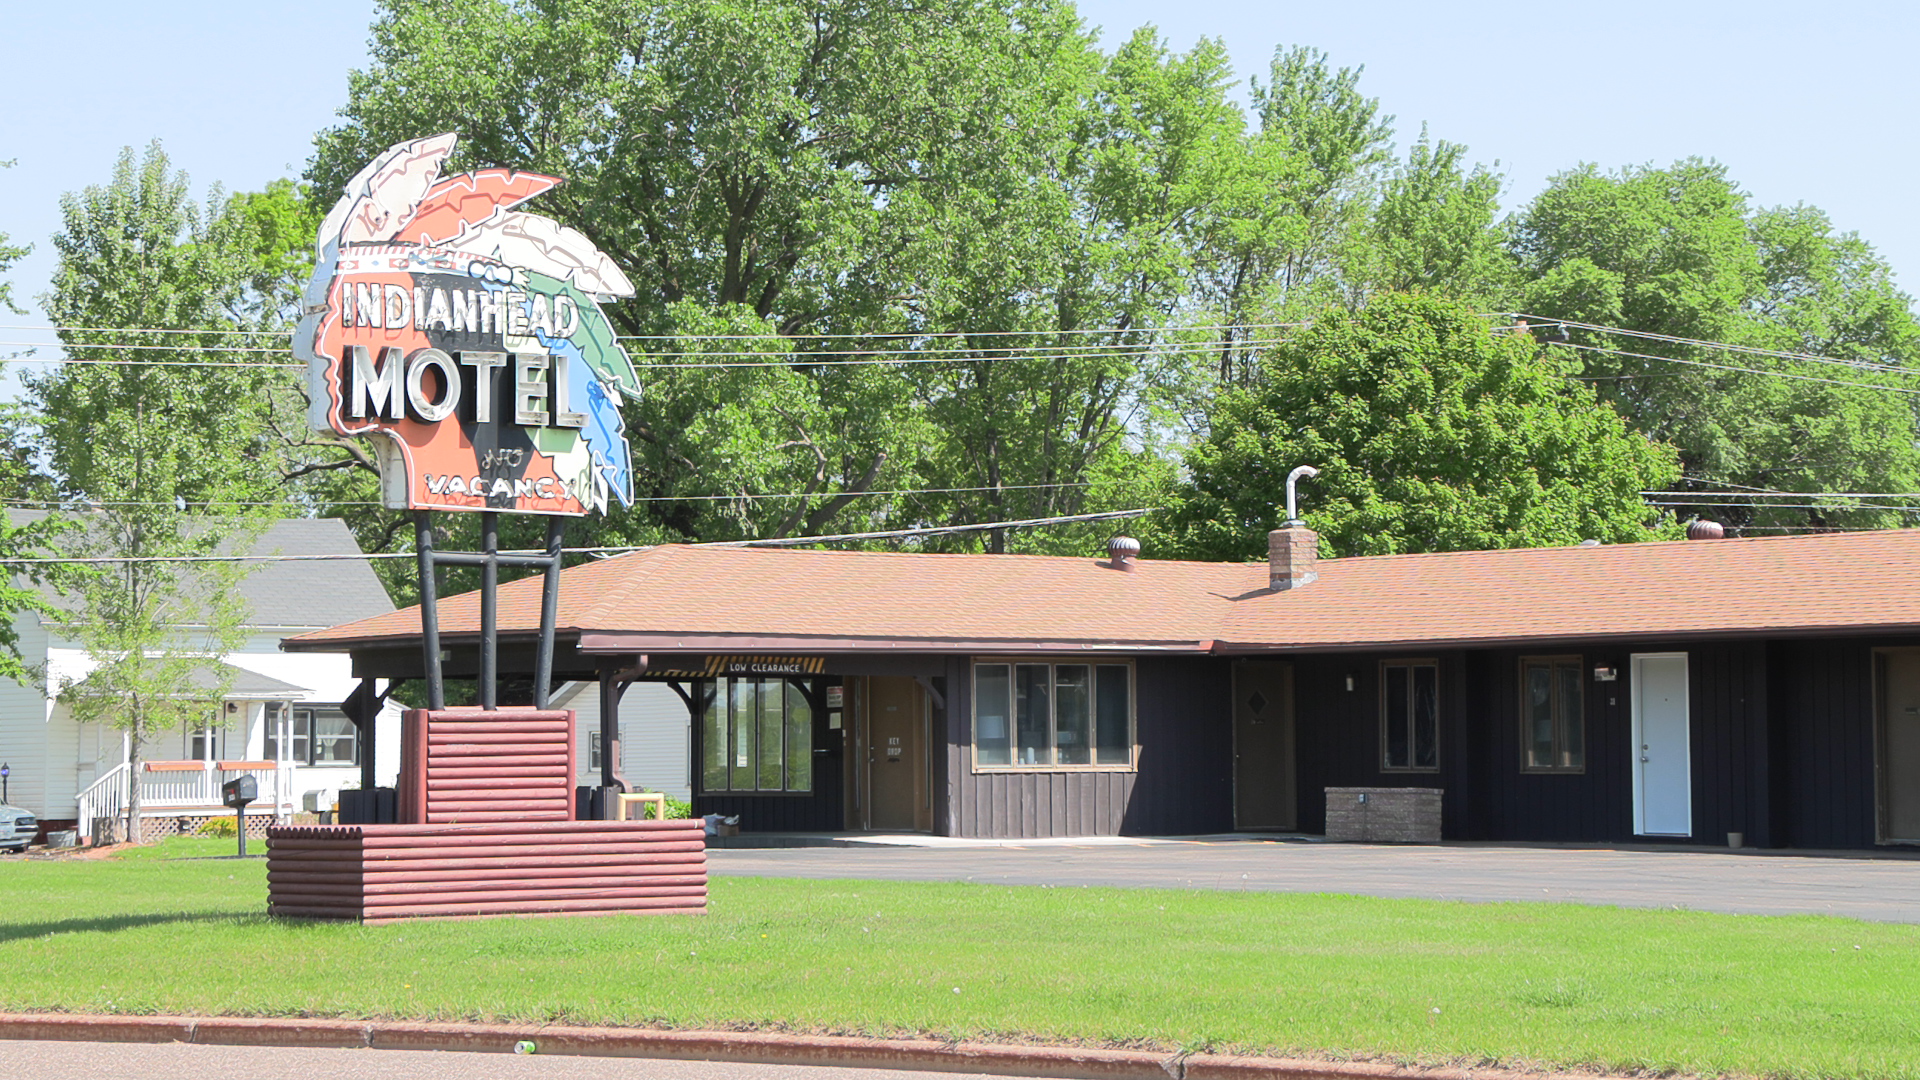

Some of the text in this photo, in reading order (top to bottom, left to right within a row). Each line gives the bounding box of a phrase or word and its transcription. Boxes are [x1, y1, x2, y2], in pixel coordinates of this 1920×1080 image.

[342, 282, 580, 339] INDIANHEAD
[344, 345, 590, 428] MOTEL
[423, 473, 577, 500] VACANCY
[729, 663, 801, 673] LOW CLEARANCE
